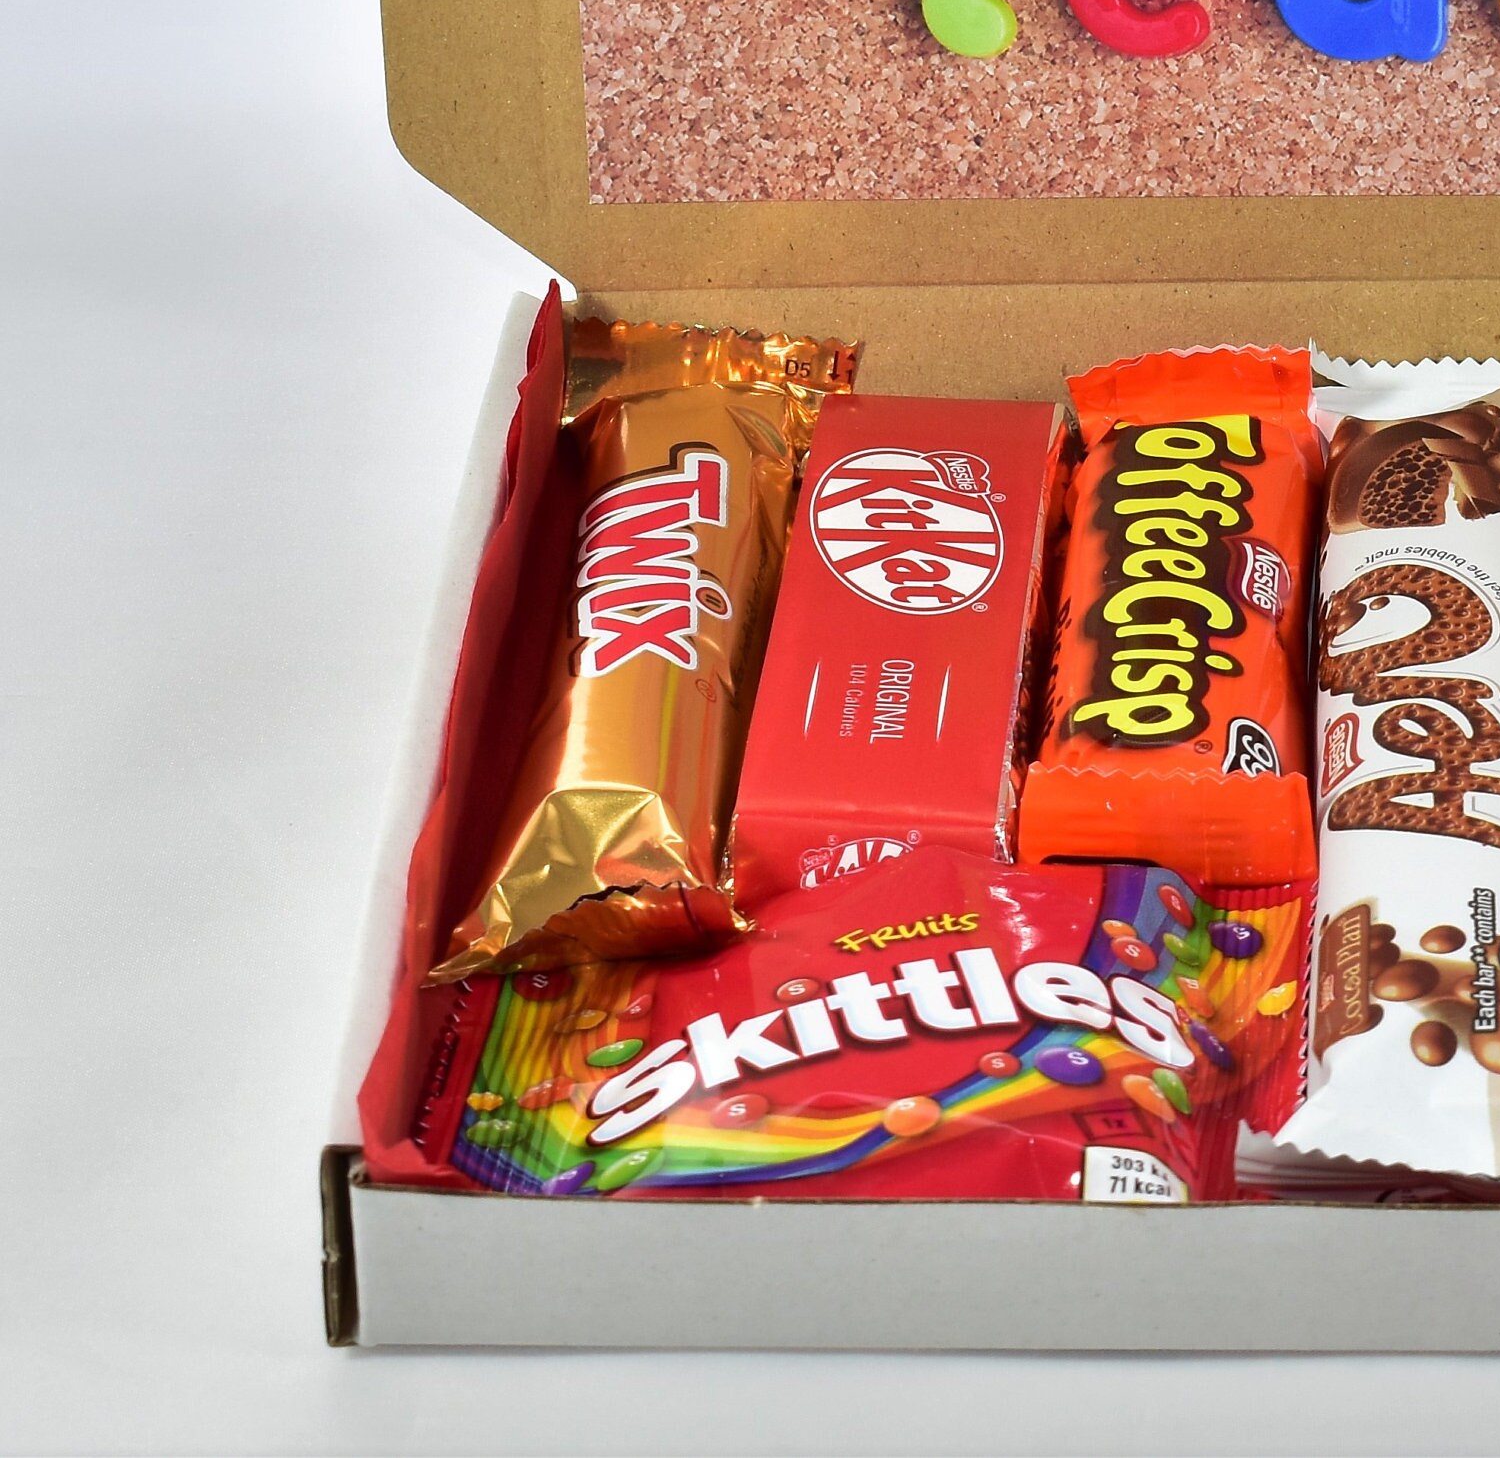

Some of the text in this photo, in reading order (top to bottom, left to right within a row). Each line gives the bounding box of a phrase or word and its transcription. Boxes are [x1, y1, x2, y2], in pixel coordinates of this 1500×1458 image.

[814, 466, 997, 605] KitKat
[1365, 547, 1399, 564] melt
[1404, 545, 1466, 568] bubbles
[1467, 564, 1490, 583] the
[840, 664, 868, 737] 104 Calories
[869, 659, 915, 744] ORIGINAL
[1468, 887, 1495, 945] contains
[1336, 914, 1363, 1035] Cocoa Plan
[1472, 993, 1497, 1032] Each
[587, 948, 1195, 1145] Skittles
[1109, 1176, 1127, 1193] 71
[1111, 1155, 1144, 1172] 303
